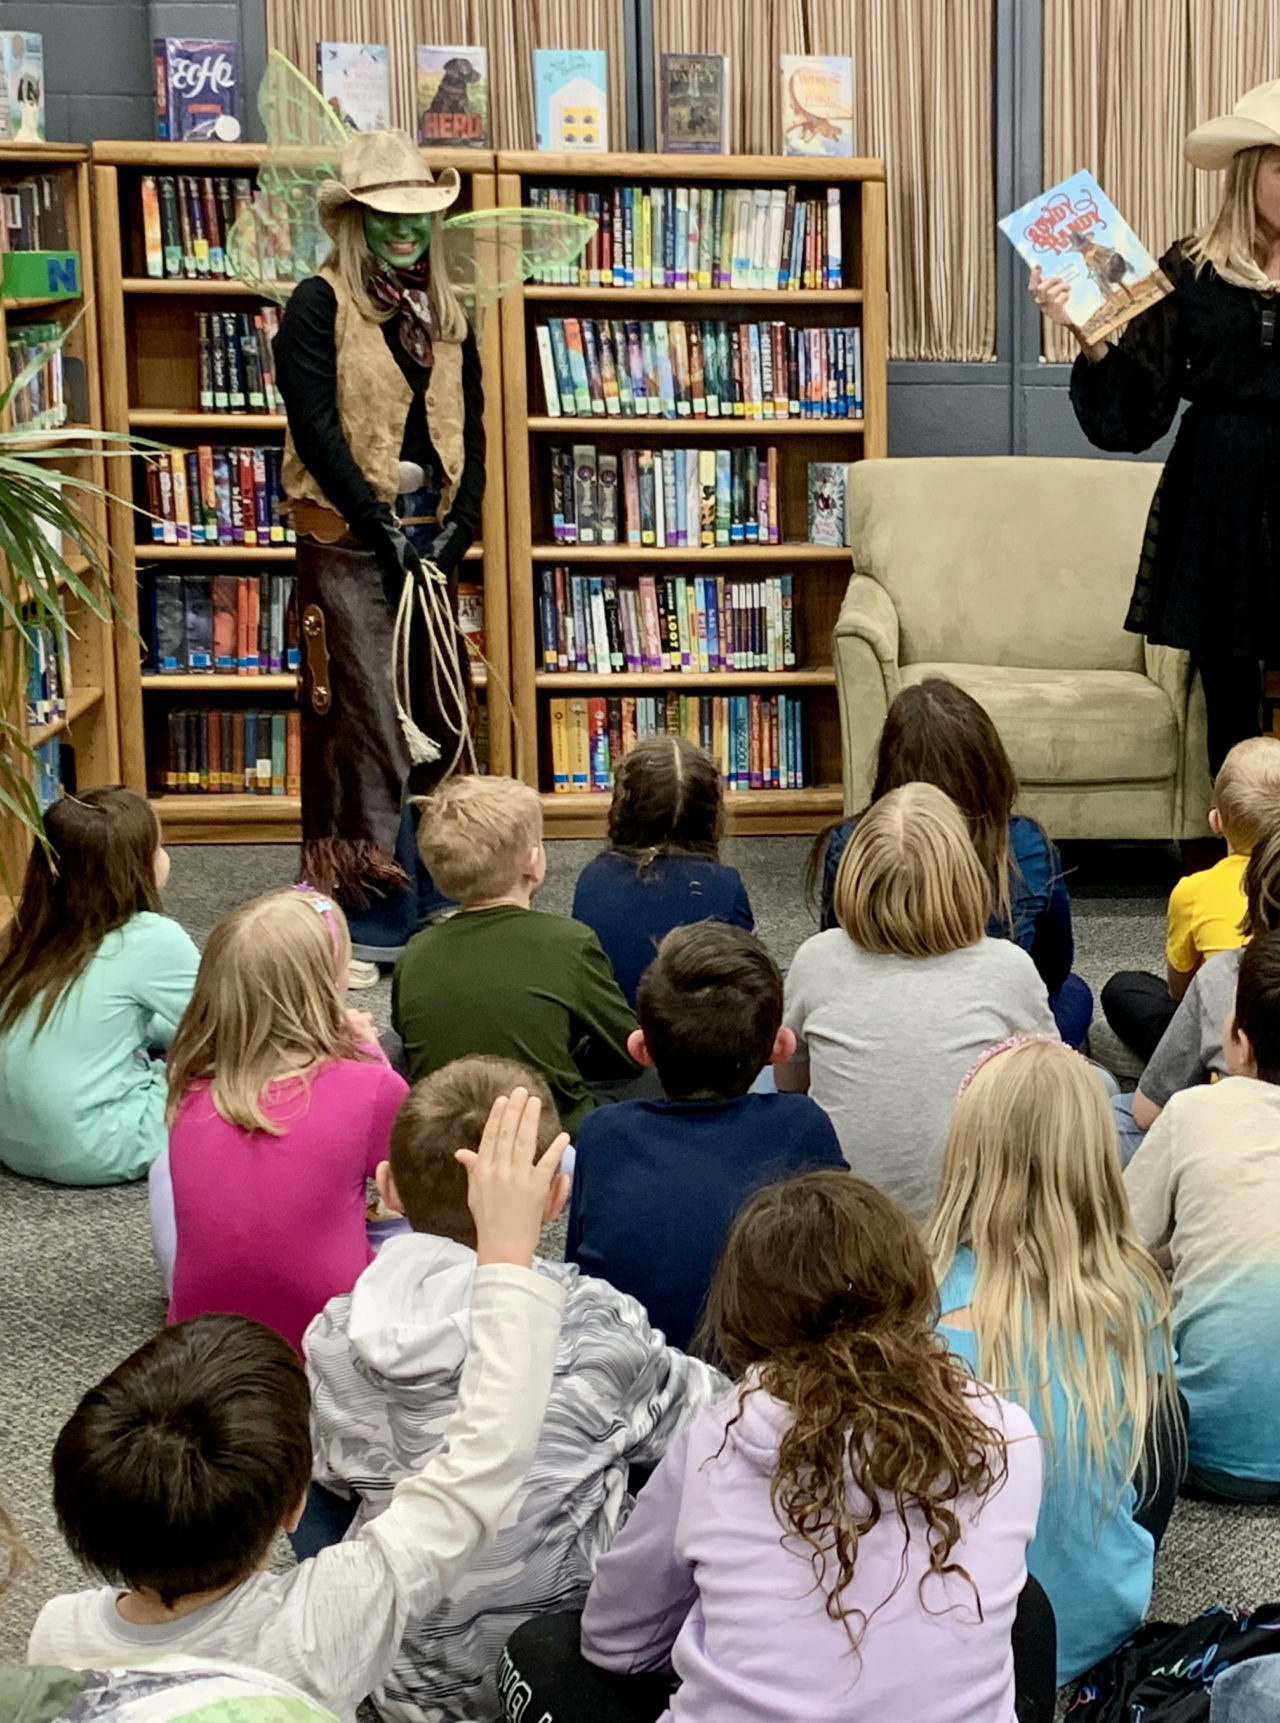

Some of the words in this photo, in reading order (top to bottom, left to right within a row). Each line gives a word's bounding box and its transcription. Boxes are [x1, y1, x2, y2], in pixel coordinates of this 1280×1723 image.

[172, 53, 237, 99] ECHO
[424, 113, 481, 138] HERO
[46, 258, 77, 293] N
[667, 615, 679, 648] LOOT
